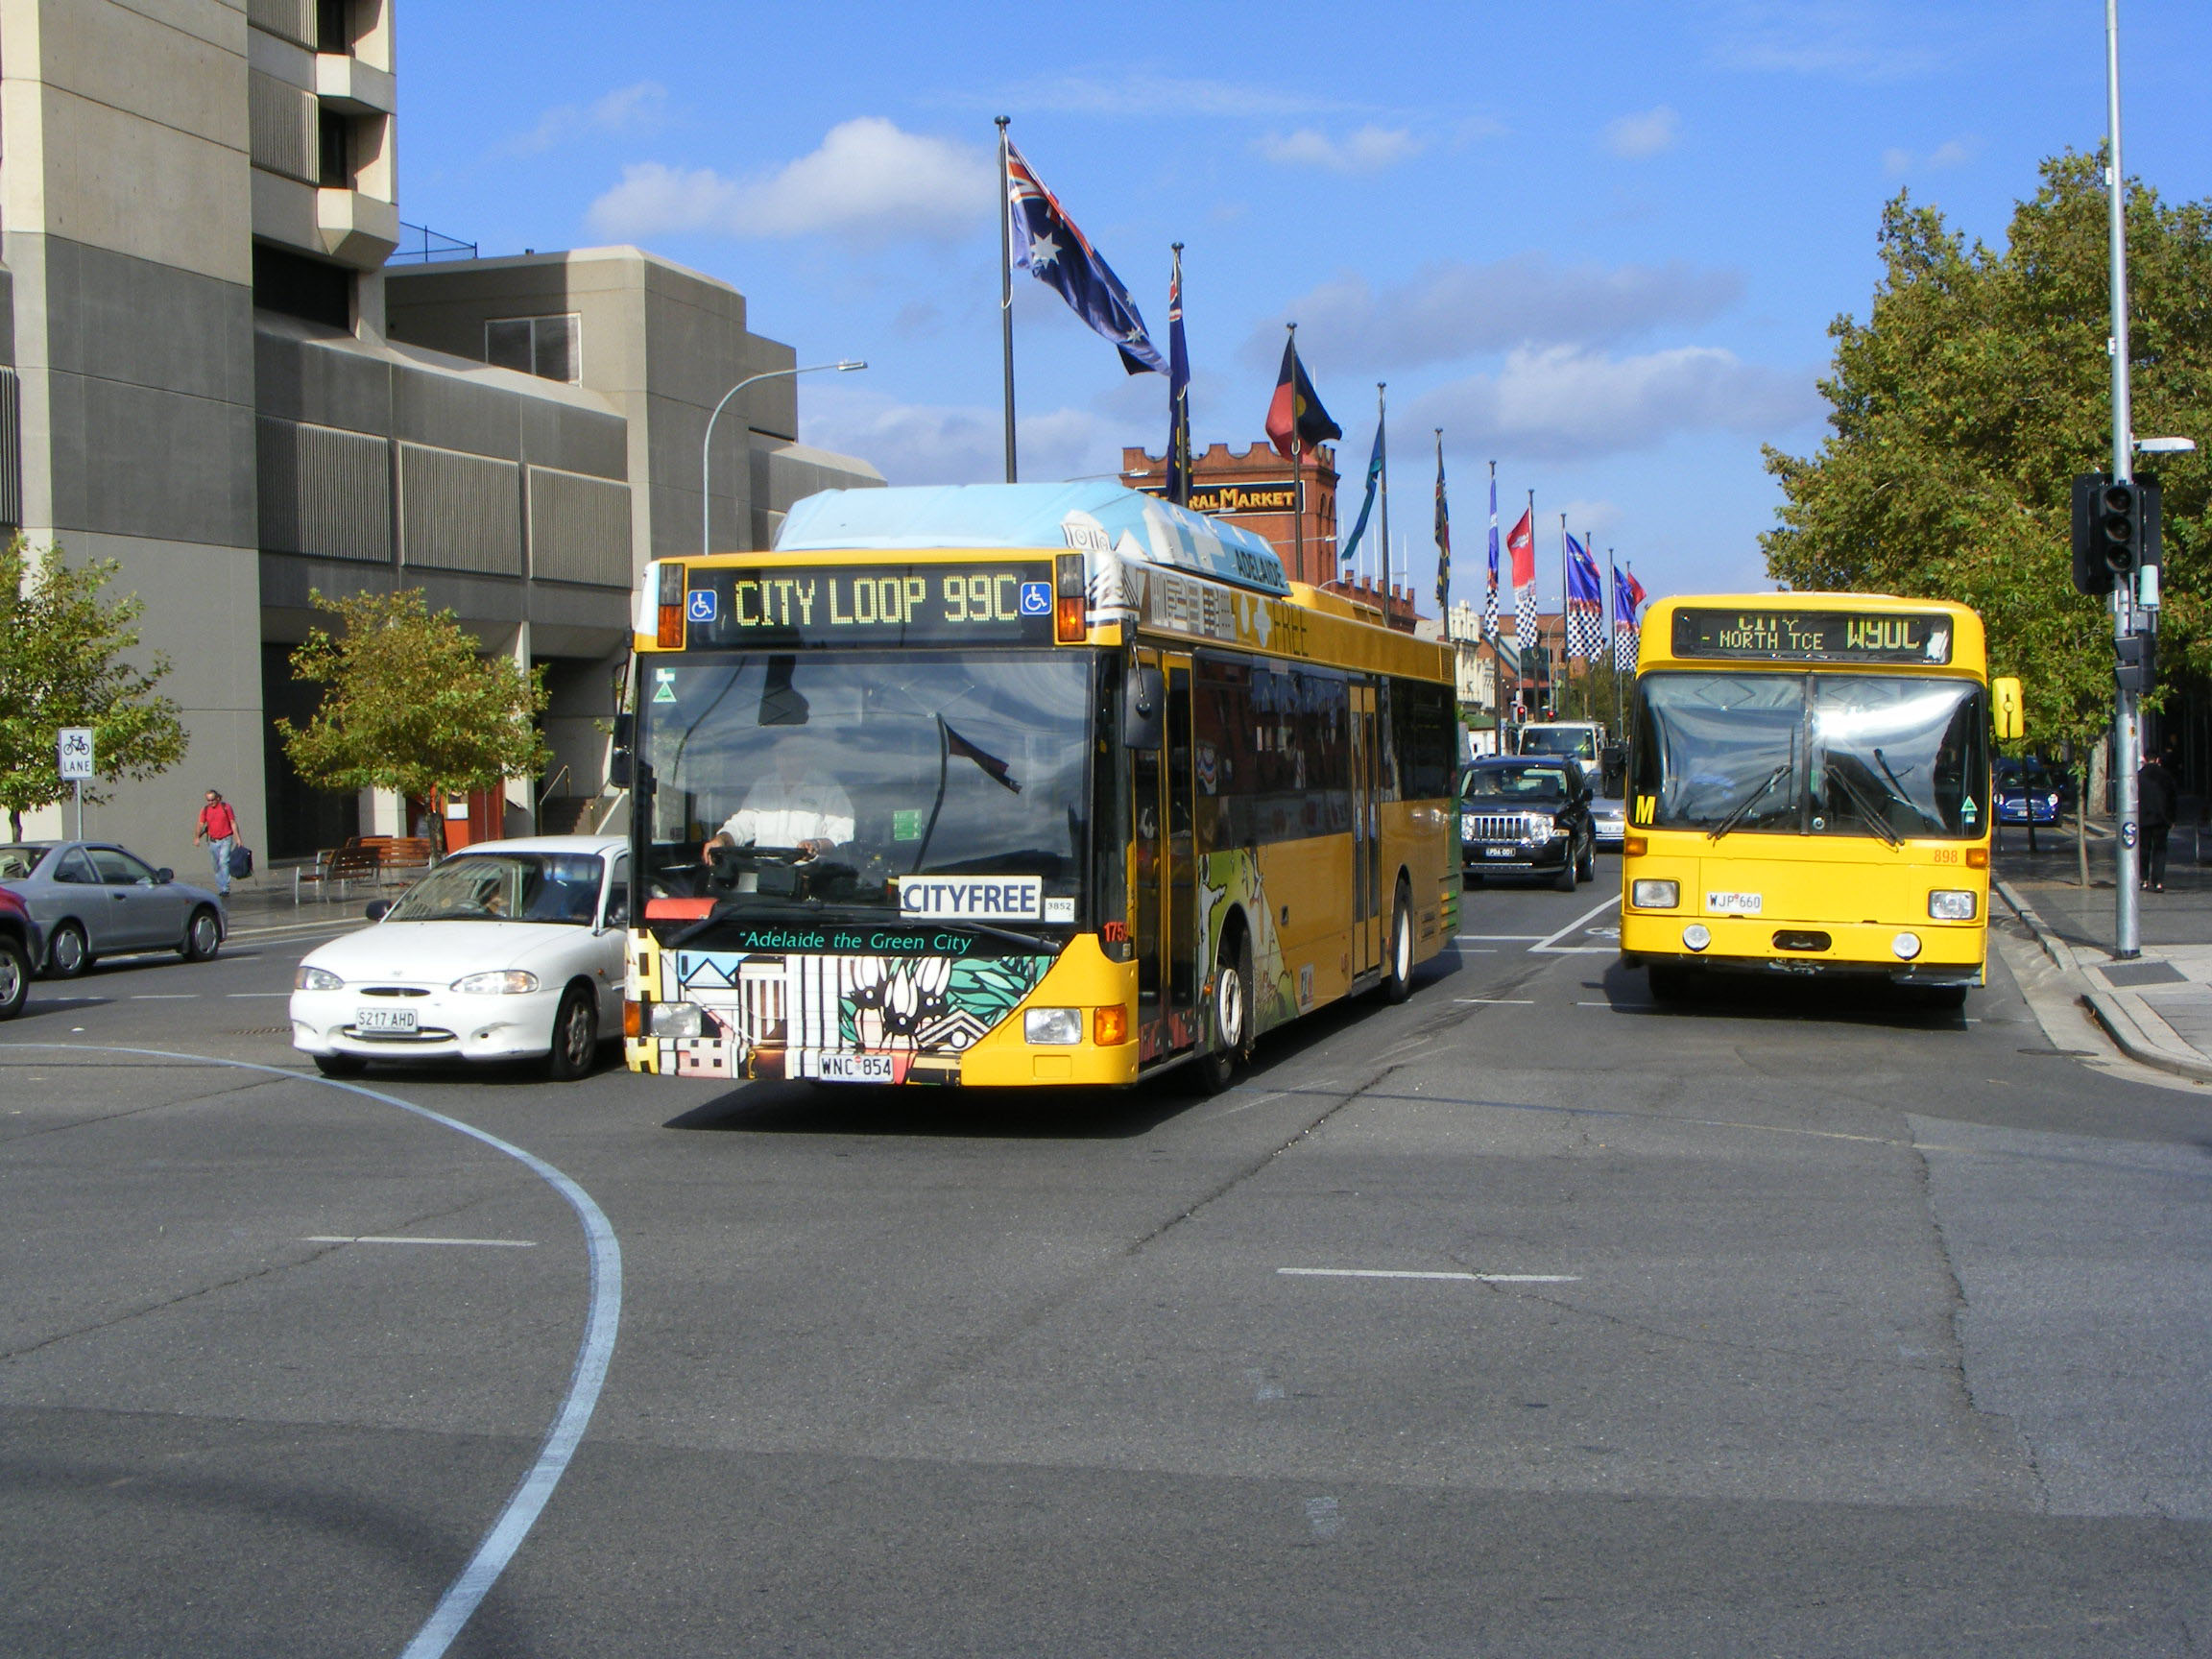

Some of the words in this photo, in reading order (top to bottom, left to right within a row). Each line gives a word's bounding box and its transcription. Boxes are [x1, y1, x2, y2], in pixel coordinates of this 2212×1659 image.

[1219, 488, 1294, 509] MARKET
[1235, 548, 1285, 589] ADELAIDE
[735, 579, 815, 627] CITY
[830, 576, 926, 624] LOOP
[944, 574, 1017, 622] 99C
[1272, 600, 1309, 657] FREE
[1738, 615, 1799, 632] CITY
[1719, 630, 1778, 650] NORTH
[1789, 632, 1823, 651] TCE
[63, 760, 90, 773] LANE
[1635, 795, 1656, 826] M
[1934, 849, 1958, 864] 898
[903, 883, 1036, 913] CITYFREE
[1047, 902, 1071, 911] 3852
[1710, 894, 1734, 907] WJP
[1740, 896, 1761, 908] 660
[833, 933, 862, 949] the
[870, 932, 925, 950] Green
[933, 933, 972, 954] City
[358, 1012, 387, 1025] S217
[391, 1013, 415, 1026] AHD
[821, 1057, 854, 1075] WNC
[862, 1058, 891, 1076] 854
